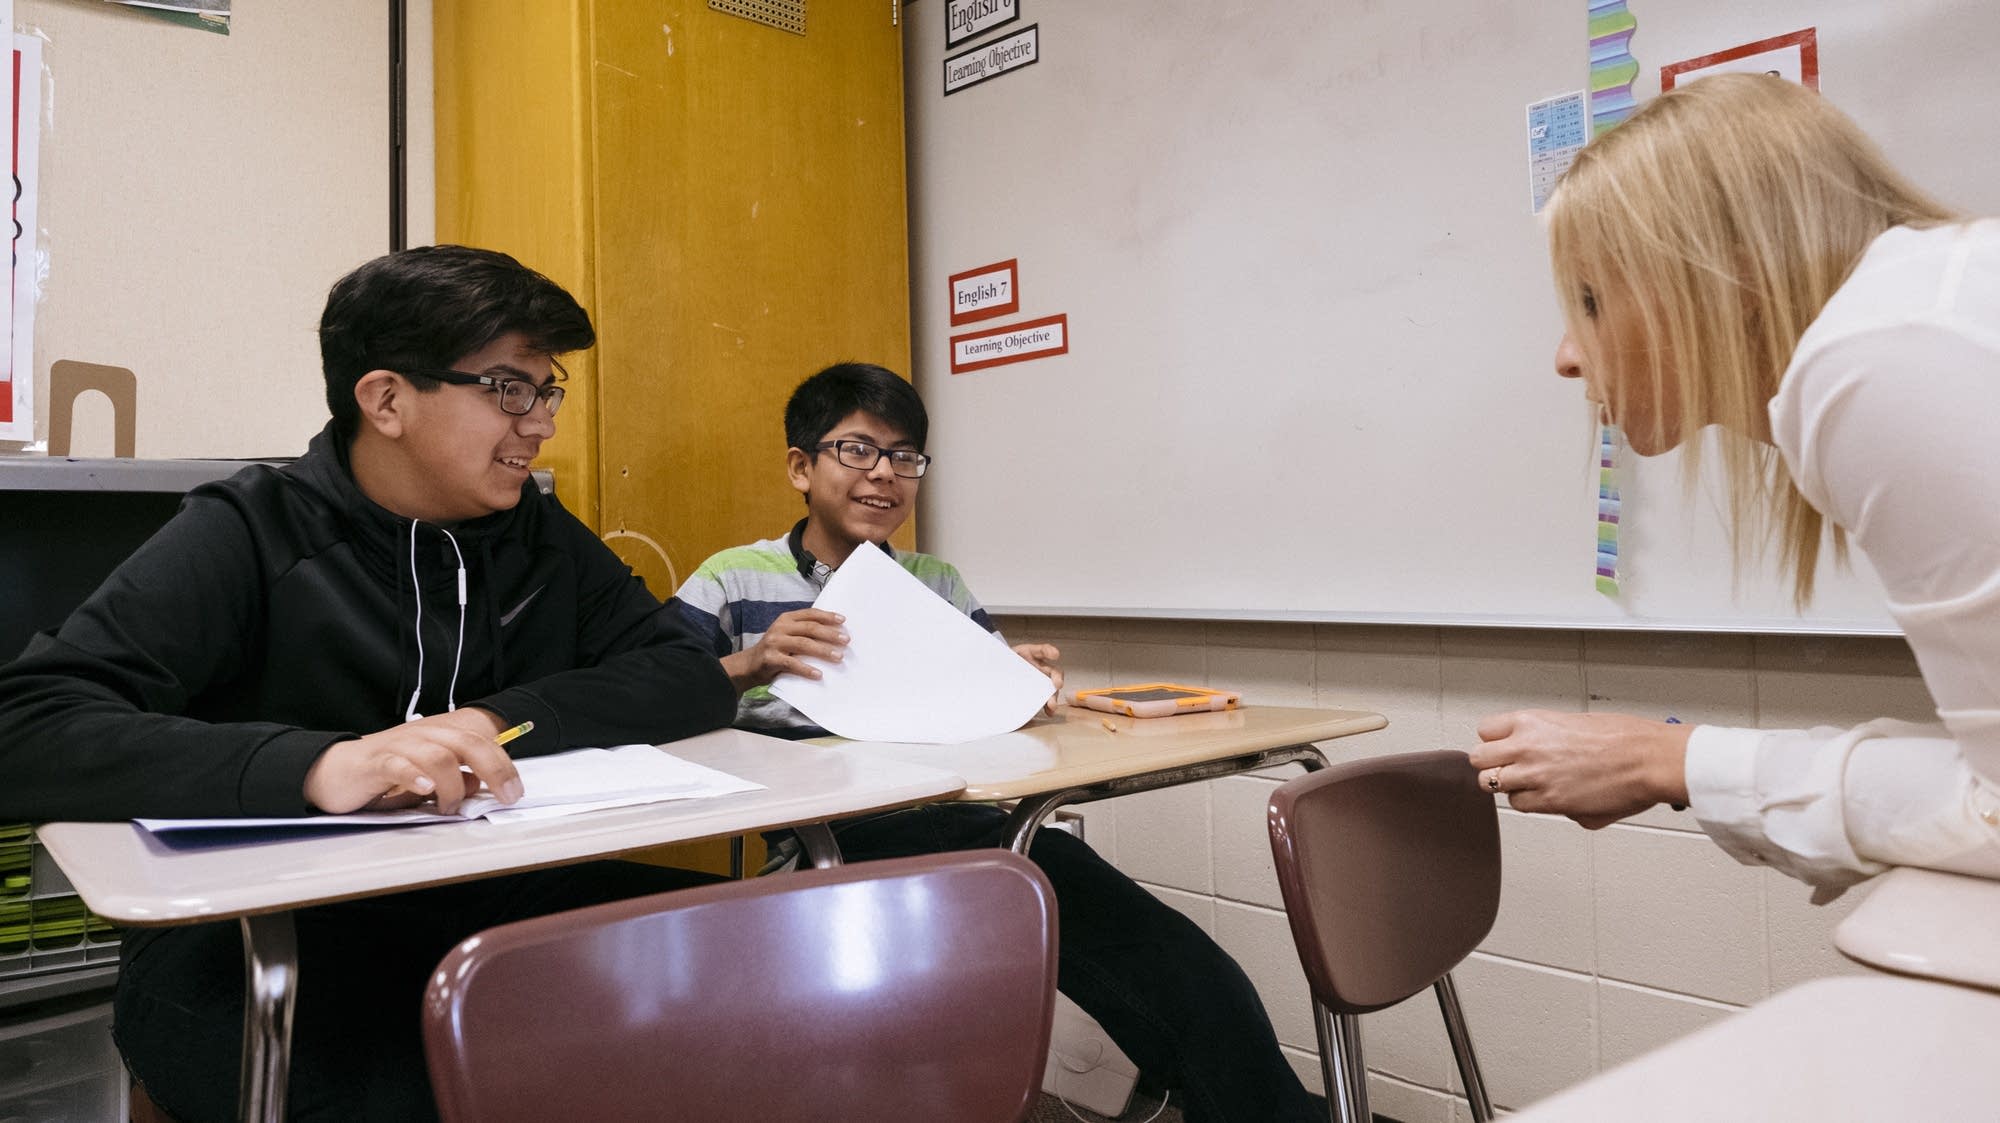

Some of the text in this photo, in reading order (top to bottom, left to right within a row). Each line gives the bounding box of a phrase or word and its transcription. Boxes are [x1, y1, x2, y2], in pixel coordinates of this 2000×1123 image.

[948, 40, 1032, 84] Learning Objective
[958, 281, 1007, 306] English 7
[965, 331, 1050, 355] Learning Objective
